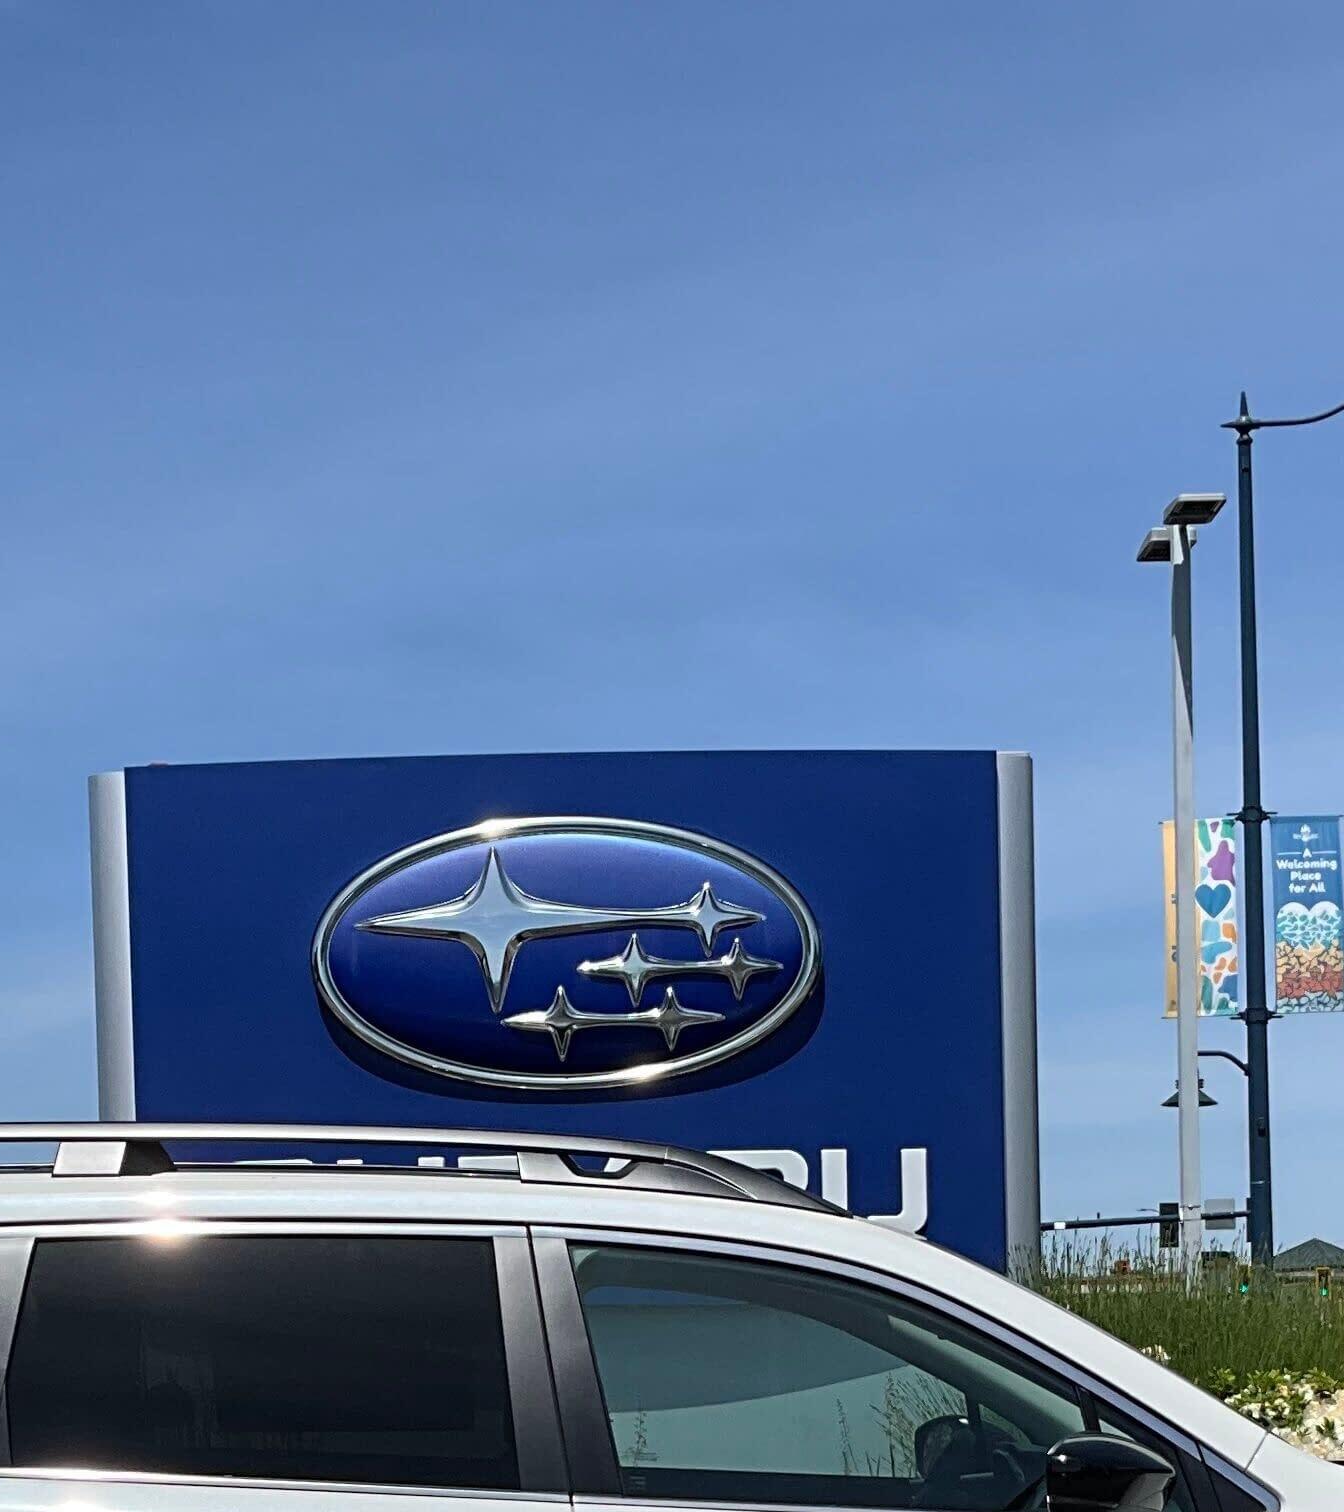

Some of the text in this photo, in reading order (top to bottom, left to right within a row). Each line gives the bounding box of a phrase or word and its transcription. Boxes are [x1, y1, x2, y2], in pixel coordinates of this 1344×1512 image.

[1302, 847, 1313, 858] A
[1276, 858, 1337, 871] Welcoming
[1290, 870, 1322, 881] Place
[1288, 882, 1326, 893] for All
